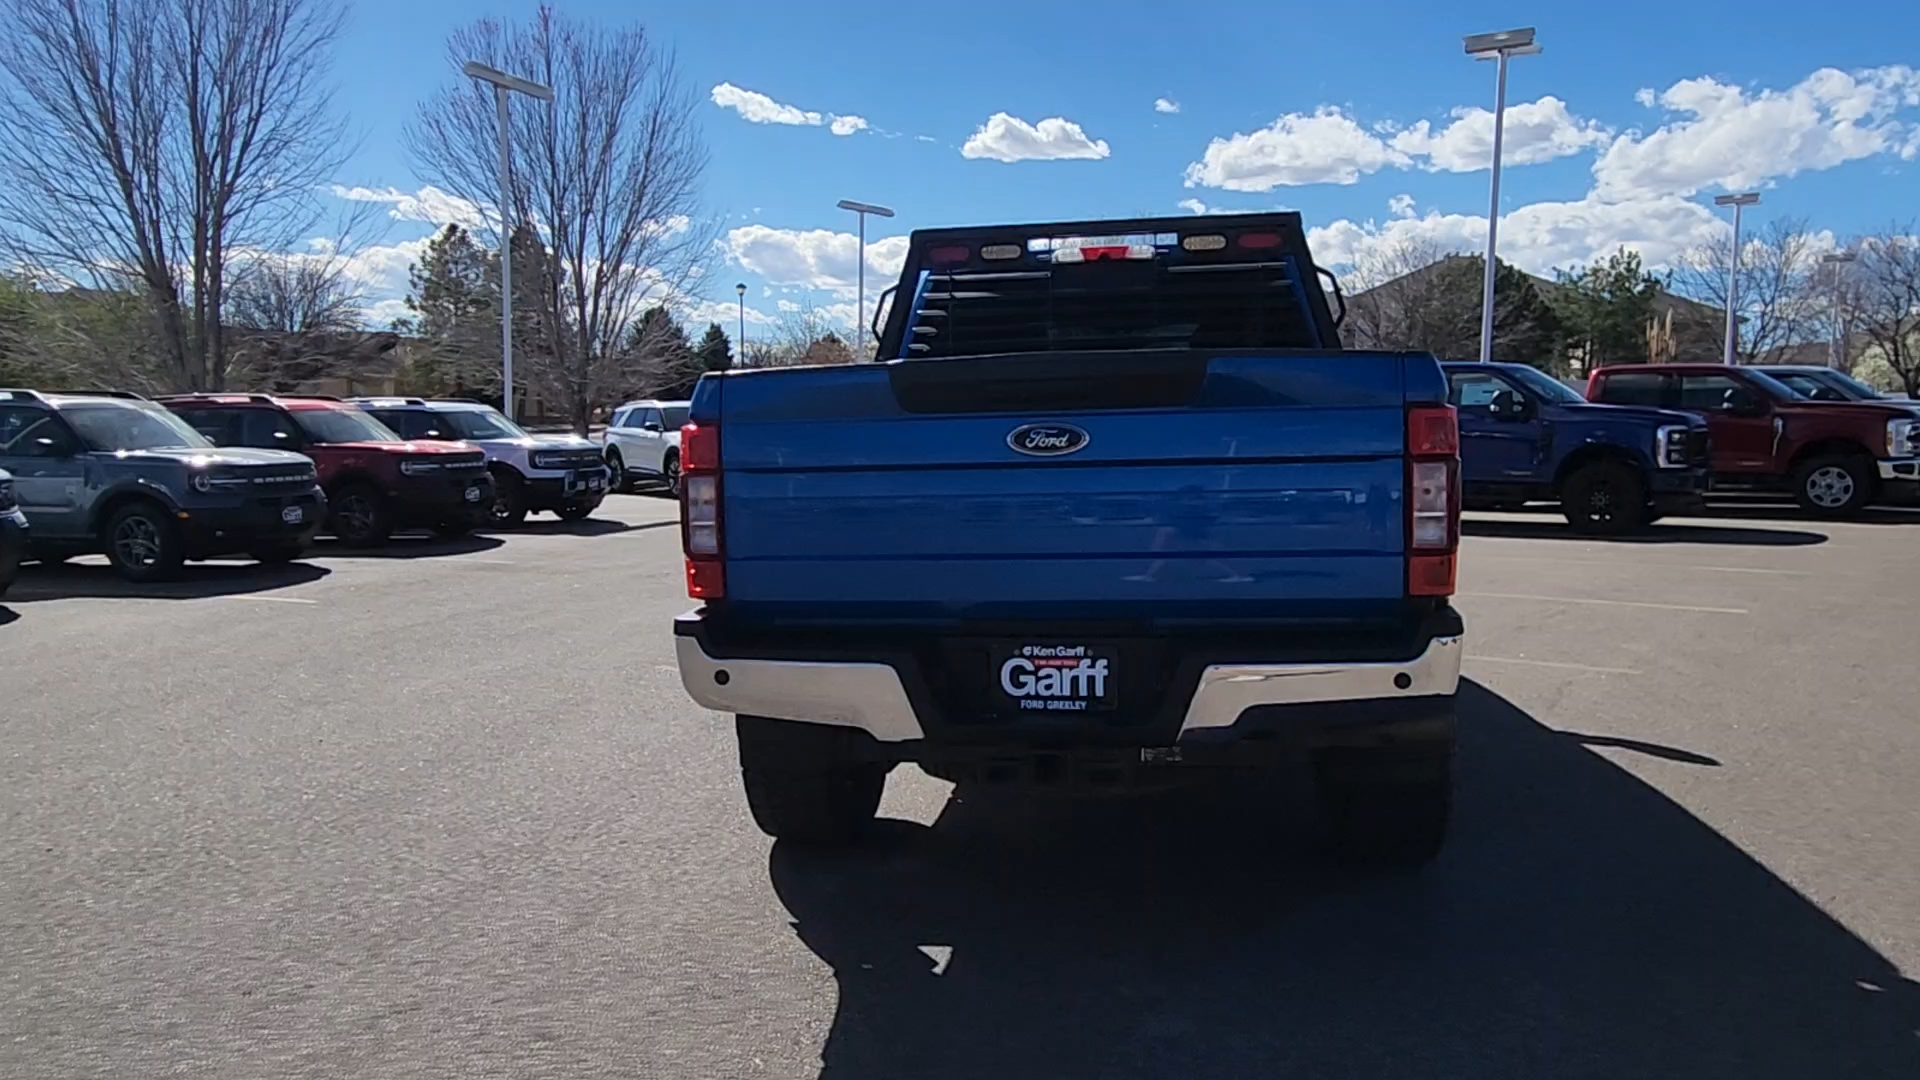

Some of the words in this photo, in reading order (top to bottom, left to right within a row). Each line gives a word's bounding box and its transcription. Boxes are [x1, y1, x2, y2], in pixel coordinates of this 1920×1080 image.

[1025, 428, 1070, 448] Ford
[1033, 646, 1055, 656] Ken
[1056, 646, 1085, 656] Garff
[1001, 657, 1109, 697] Garff
[1020, 700, 1044, 709] FORD
[1047, 700, 1087, 710] GREELEY
